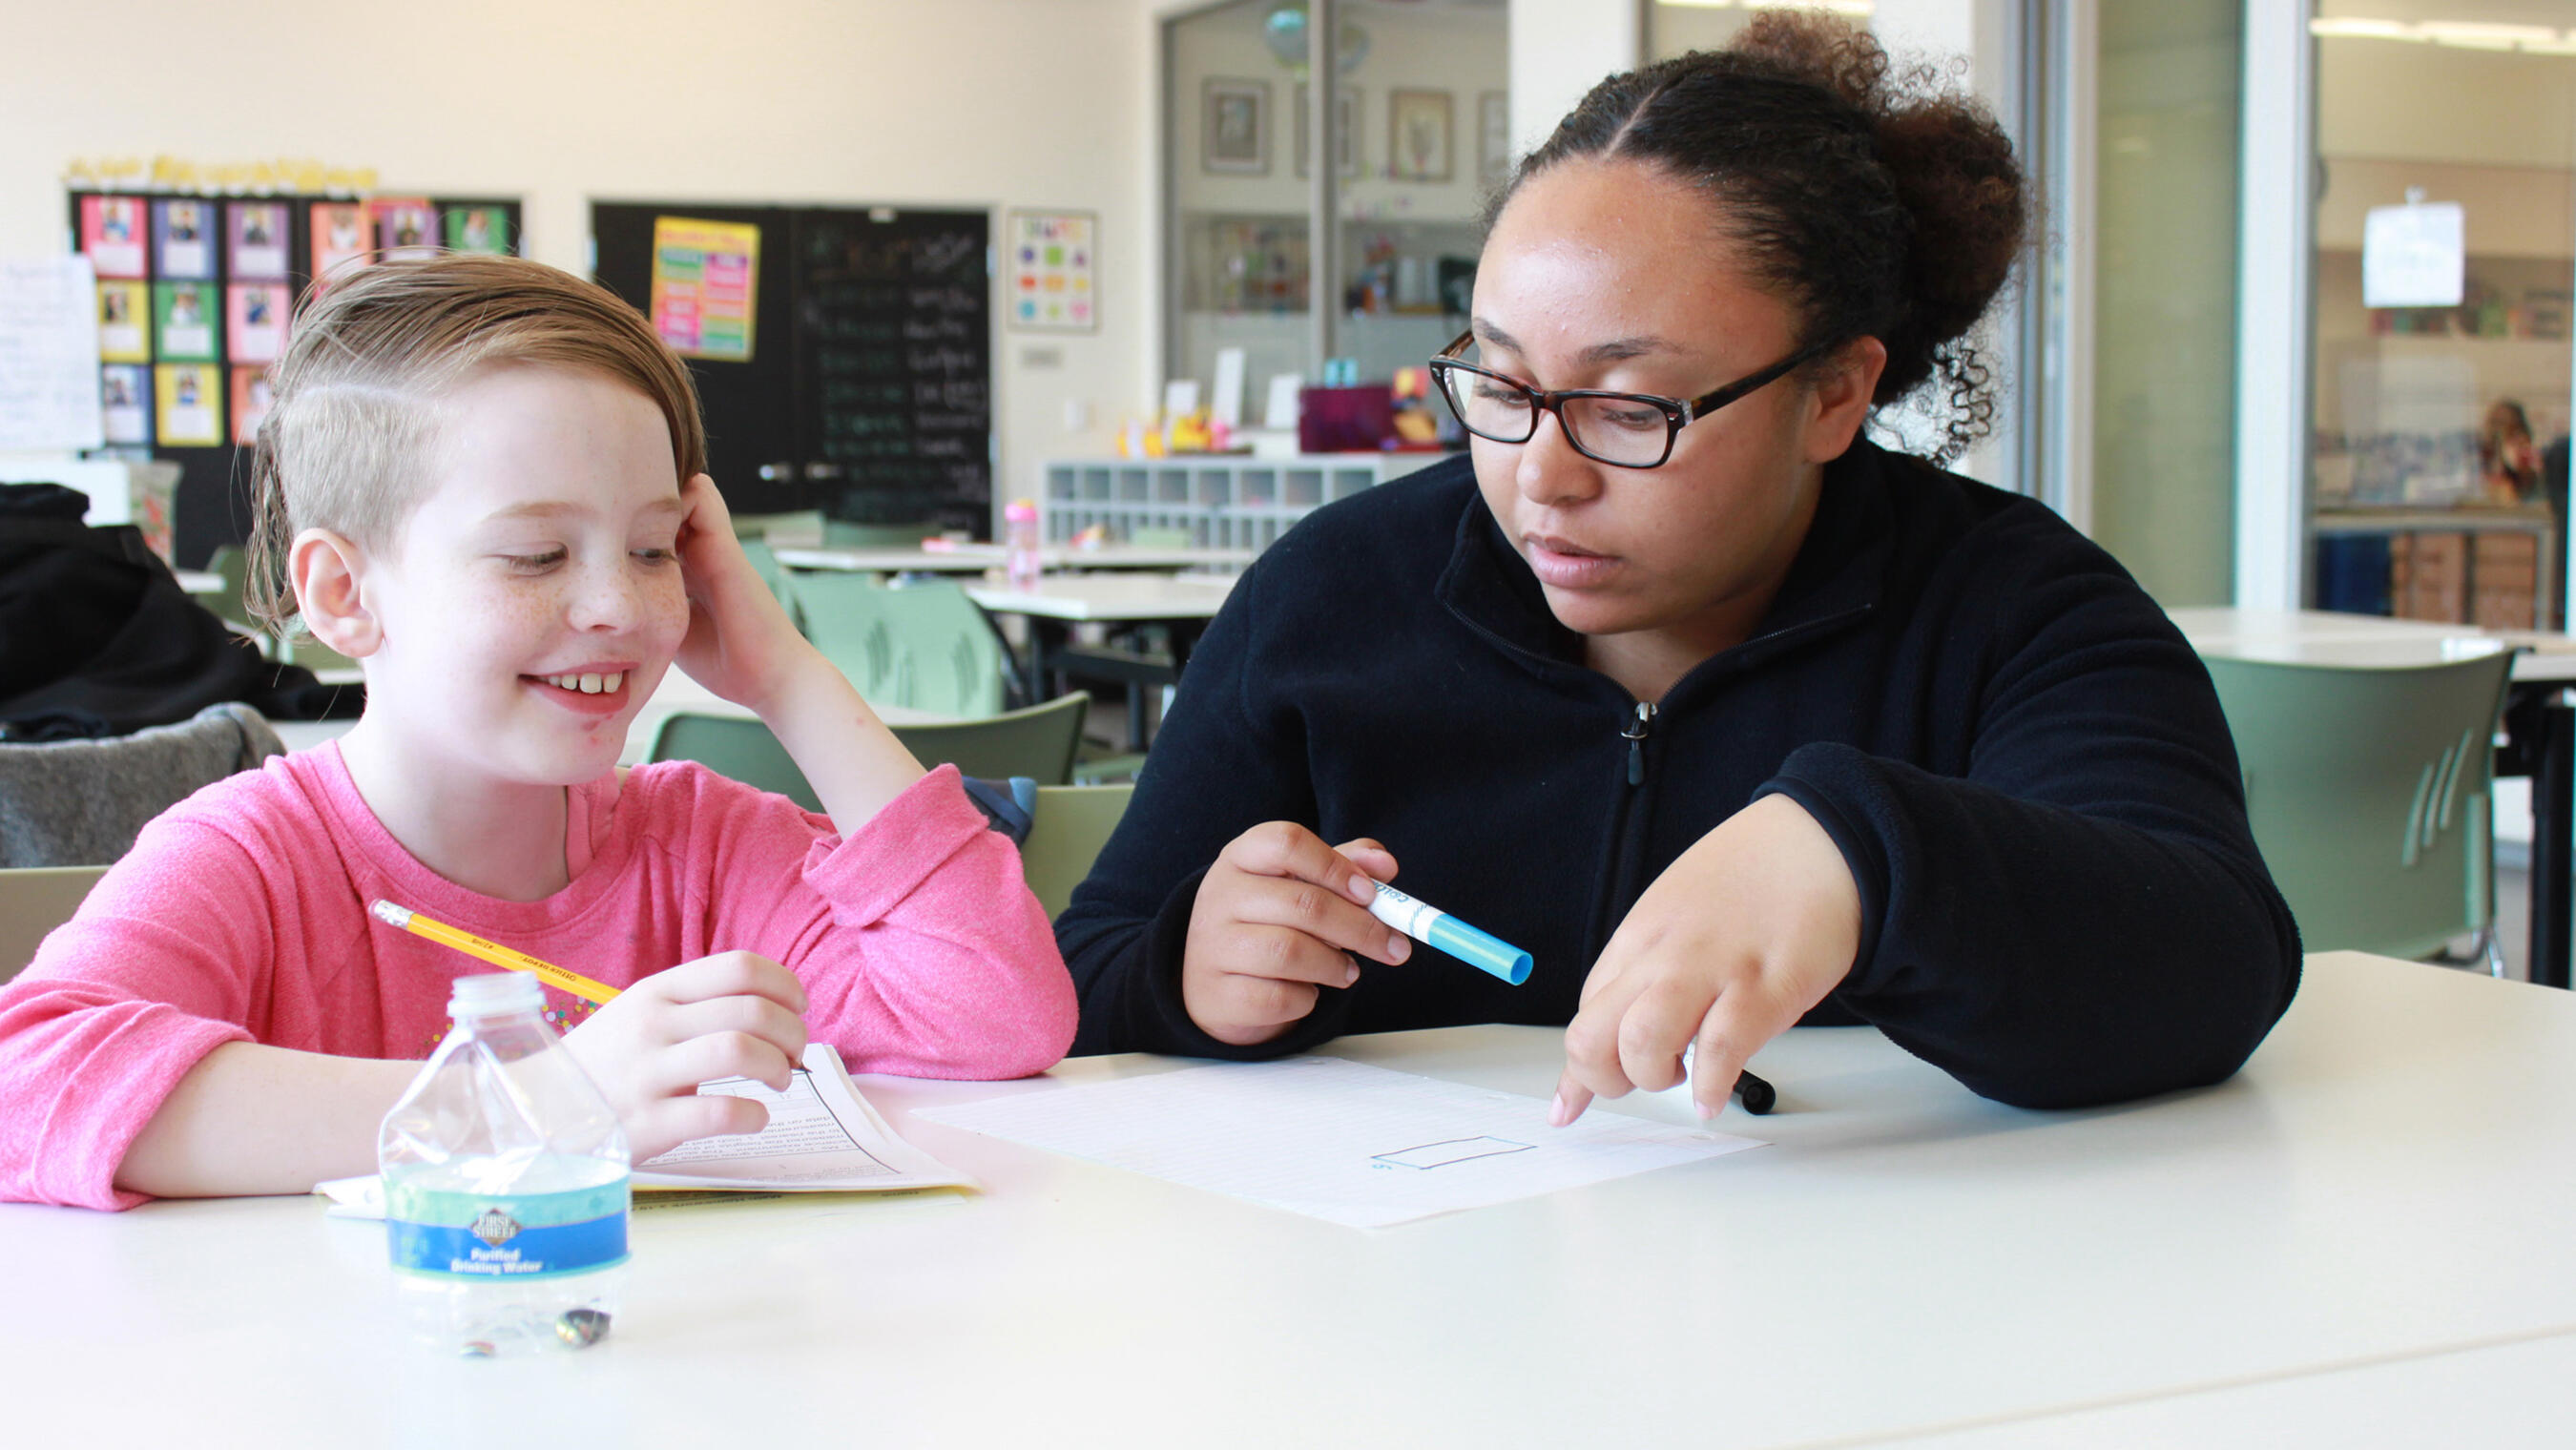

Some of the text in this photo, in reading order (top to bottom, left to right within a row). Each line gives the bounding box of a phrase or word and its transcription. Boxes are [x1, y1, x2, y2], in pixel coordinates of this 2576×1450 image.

[470, 1247, 522, 1262] Purified
[450, 1257, 544, 1275] Drinking Water
